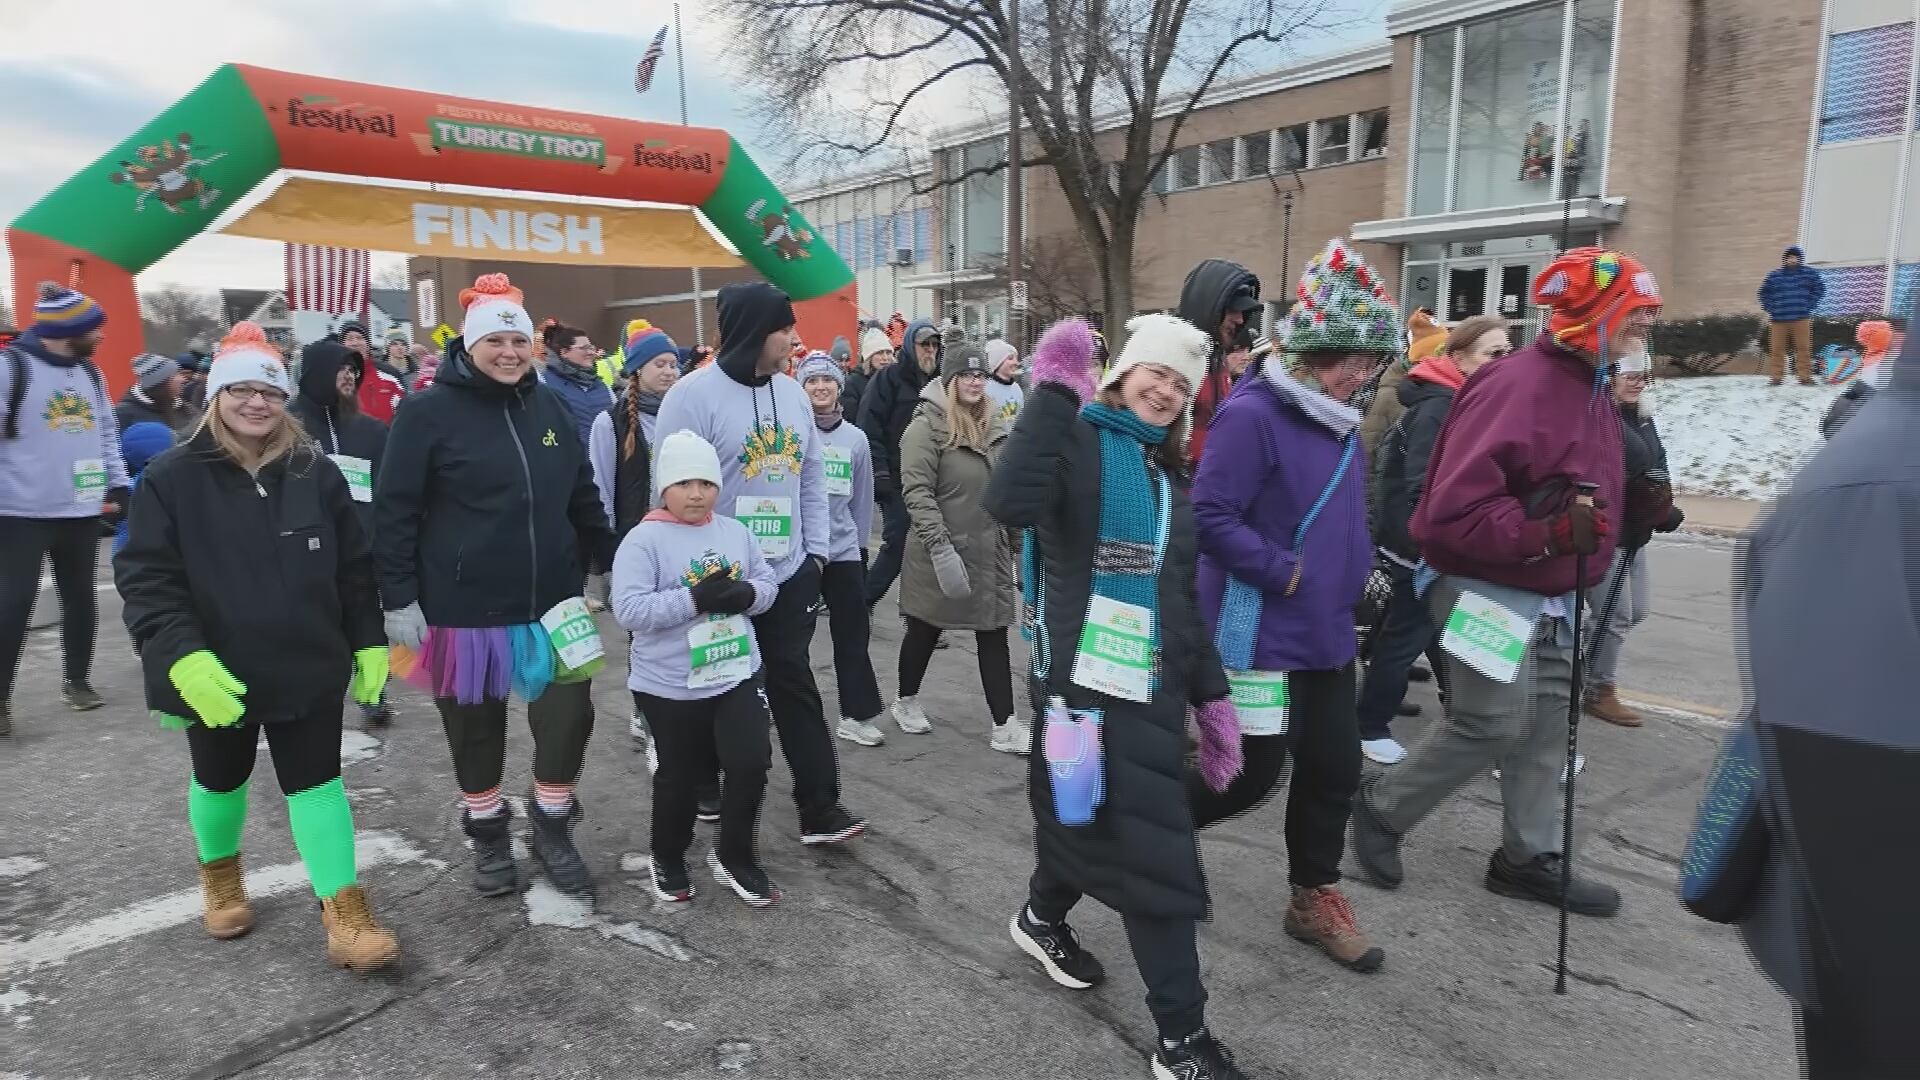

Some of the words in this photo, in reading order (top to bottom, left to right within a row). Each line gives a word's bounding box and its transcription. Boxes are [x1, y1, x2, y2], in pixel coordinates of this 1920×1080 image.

[287, 96, 397, 138] festival
[436, 103, 530, 127] FESTIVAL
[534, 116, 596, 134] FOODS
[435, 122, 538, 155] TURKEY
[540, 136, 603, 160] TROT
[634, 142, 713, 174] festival
[412, 203, 605, 256] FINISH
[748, 518, 781, 534] 13118
[704, 641, 740, 664] 13119
